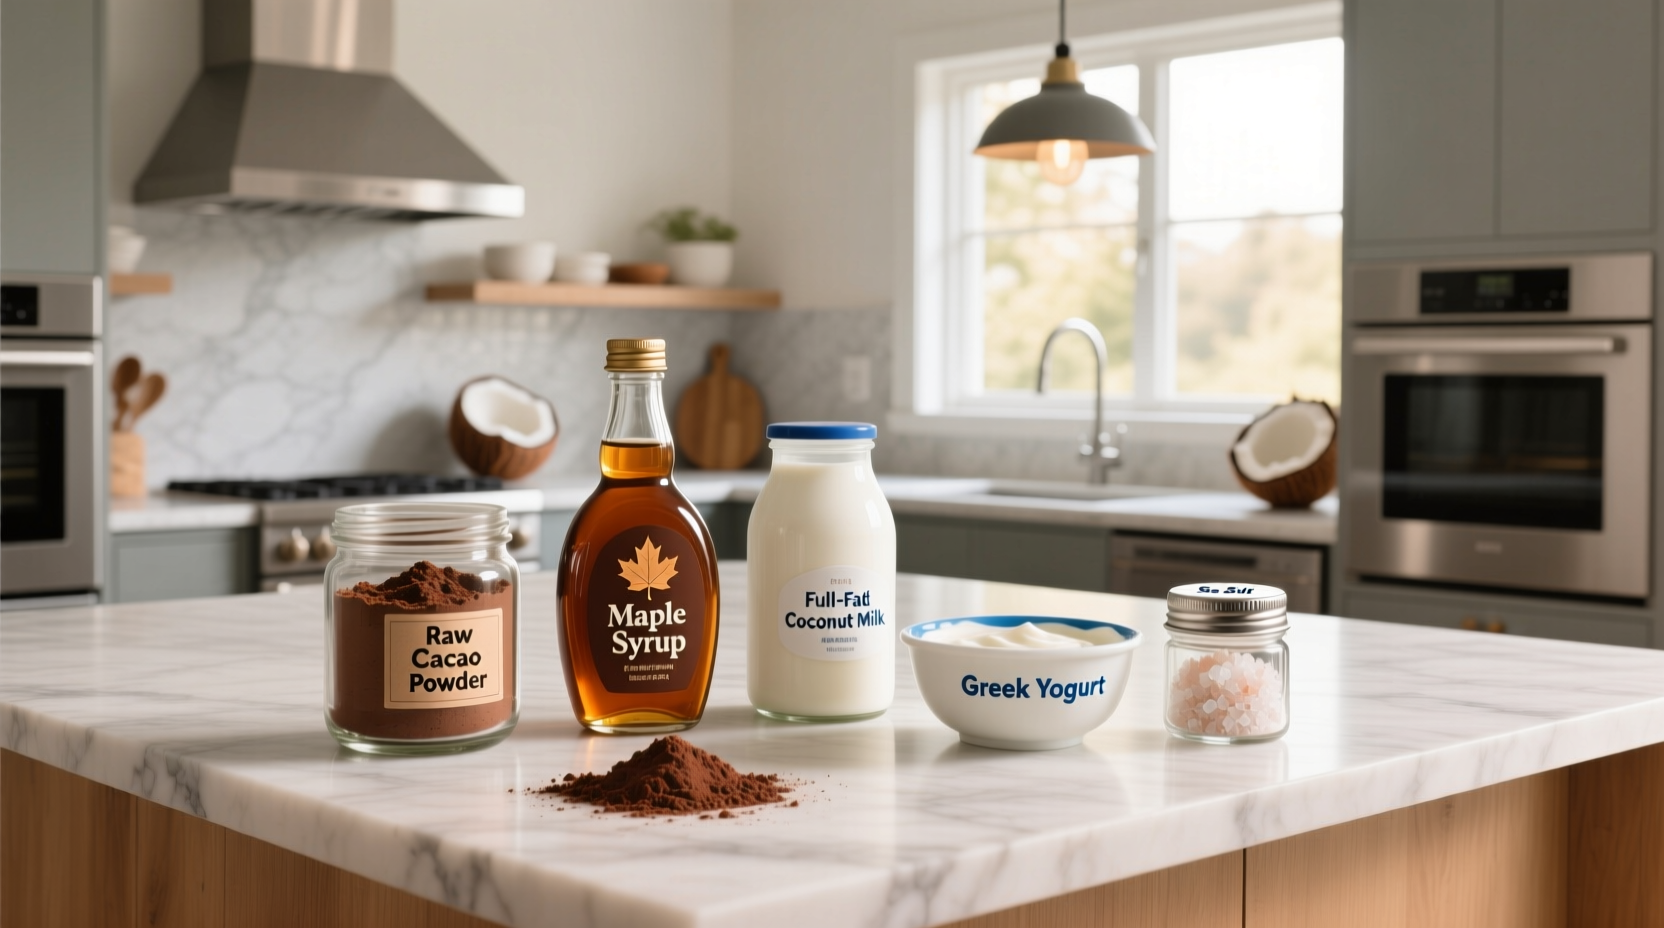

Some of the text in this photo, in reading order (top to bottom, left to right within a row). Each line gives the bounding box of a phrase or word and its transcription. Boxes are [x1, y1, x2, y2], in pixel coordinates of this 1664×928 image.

[608, 601, 686, 632] Maple
[785, 609, 885, 629] Coconut Milk
[426, 626, 473, 645] Raw
[612, 630, 686, 660] Syrup
[412, 648, 481, 668] Cacao
[410, 671, 487, 692] Powder
[961, 674, 1106, 704] Greek Yogurt
